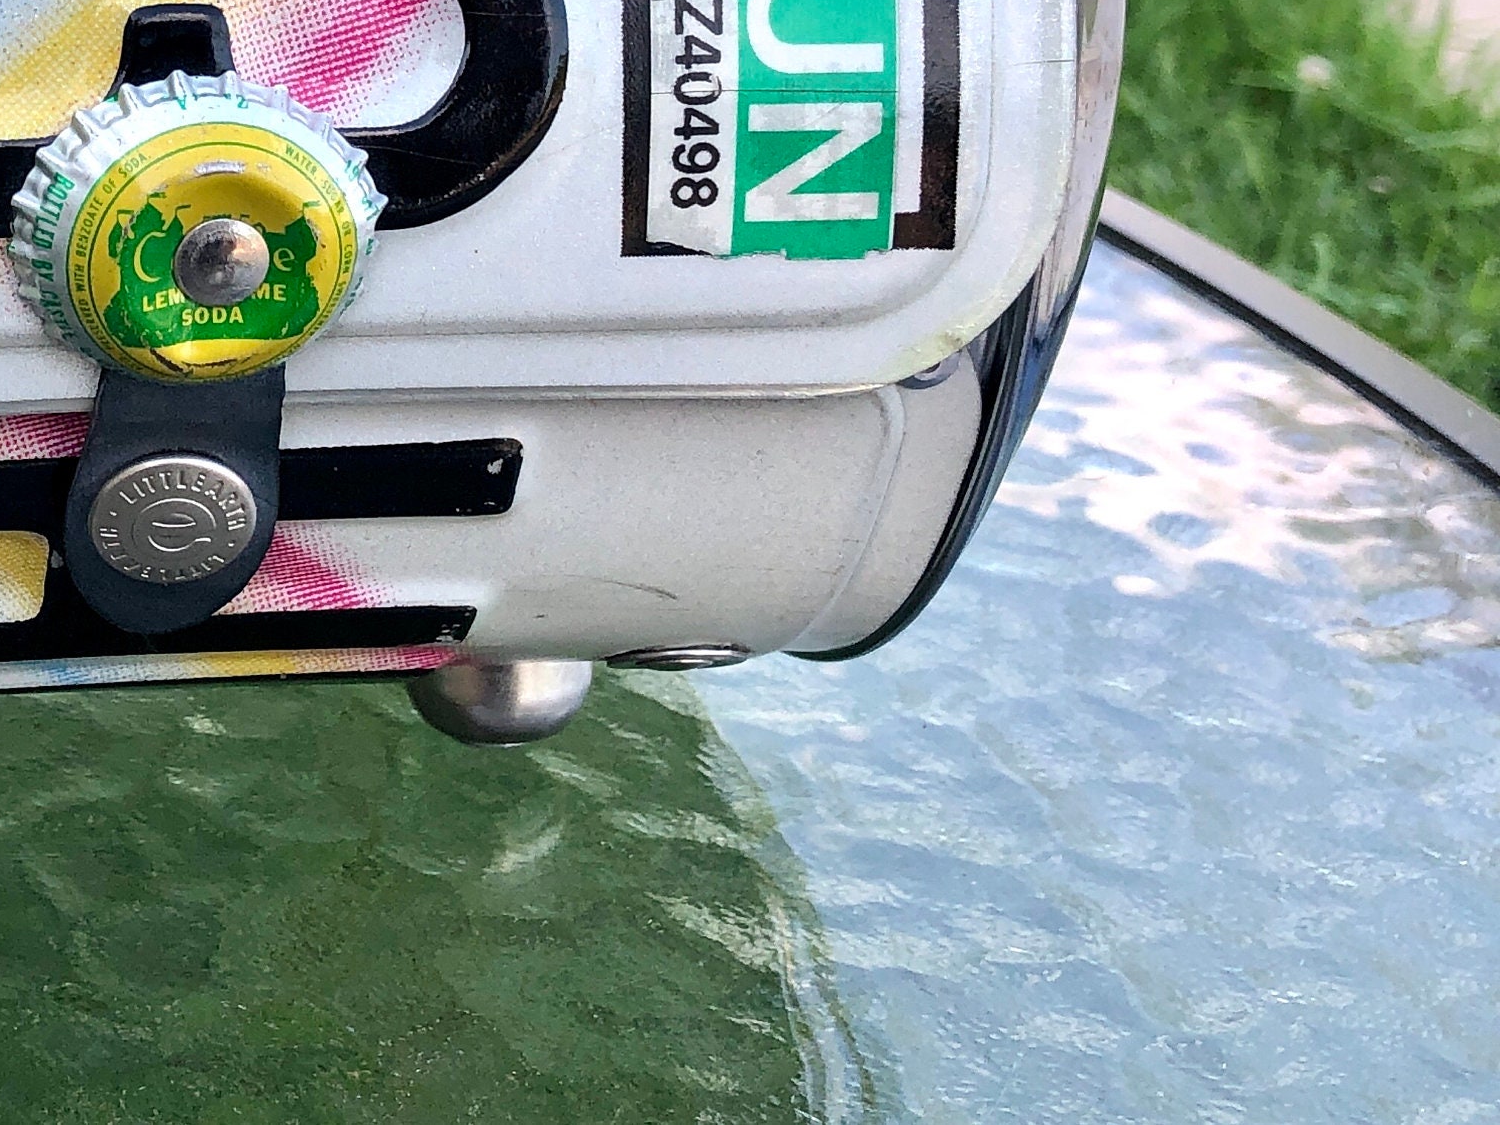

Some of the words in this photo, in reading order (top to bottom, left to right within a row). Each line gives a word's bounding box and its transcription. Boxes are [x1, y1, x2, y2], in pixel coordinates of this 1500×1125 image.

[31, 172, 76, 250] BOTTLED
[74, 264, 87, 292] WITH
[102, 179, 118, 195] OF
[31, 258, 55, 283] BY
[181, 306, 244, 326] SODA
[118, 471, 248, 531] LITTLEARTH
